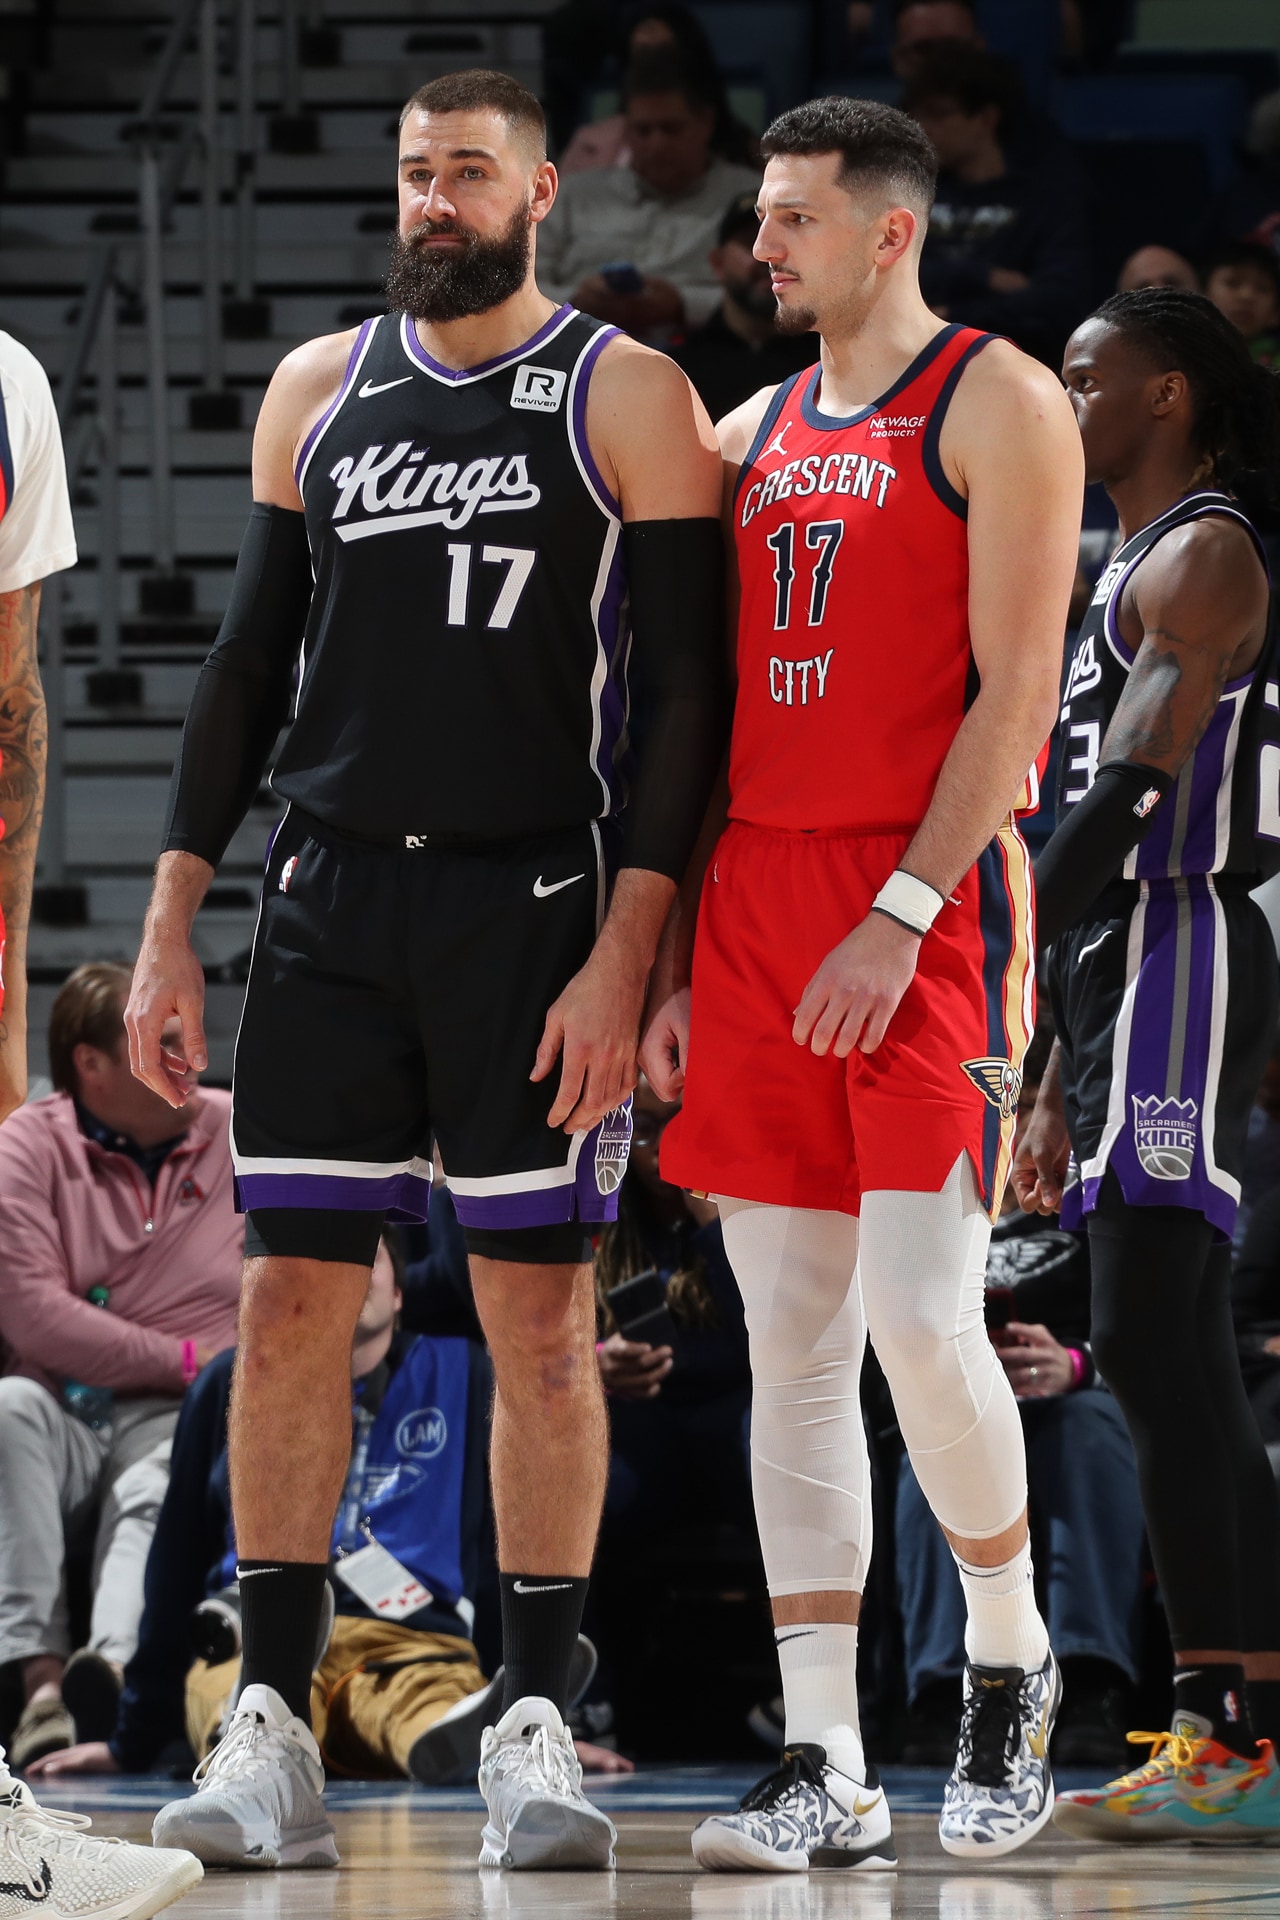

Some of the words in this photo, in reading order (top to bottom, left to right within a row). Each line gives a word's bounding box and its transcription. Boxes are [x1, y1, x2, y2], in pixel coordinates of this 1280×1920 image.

[525, 372, 552, 396] R
[514, 397, 557, 408] REVIVER
[870, 416, 926, 429] NEWAGE
[871, 429, 916, 438] PRODUCTS
[330, 440, 541, 542] Kings
[741, 453, 897, 528] CRESCENT
[767, 518, 844, 631] 17
[447, 543, 537, 629] 17
[768, 648, 834, 706] CITY
[1138, 1119, 1196, 1131] SACRAMENT
[1137, 1130, 1196, 1148] KINGS
[597, 1141, 630, 1160] KINGS
